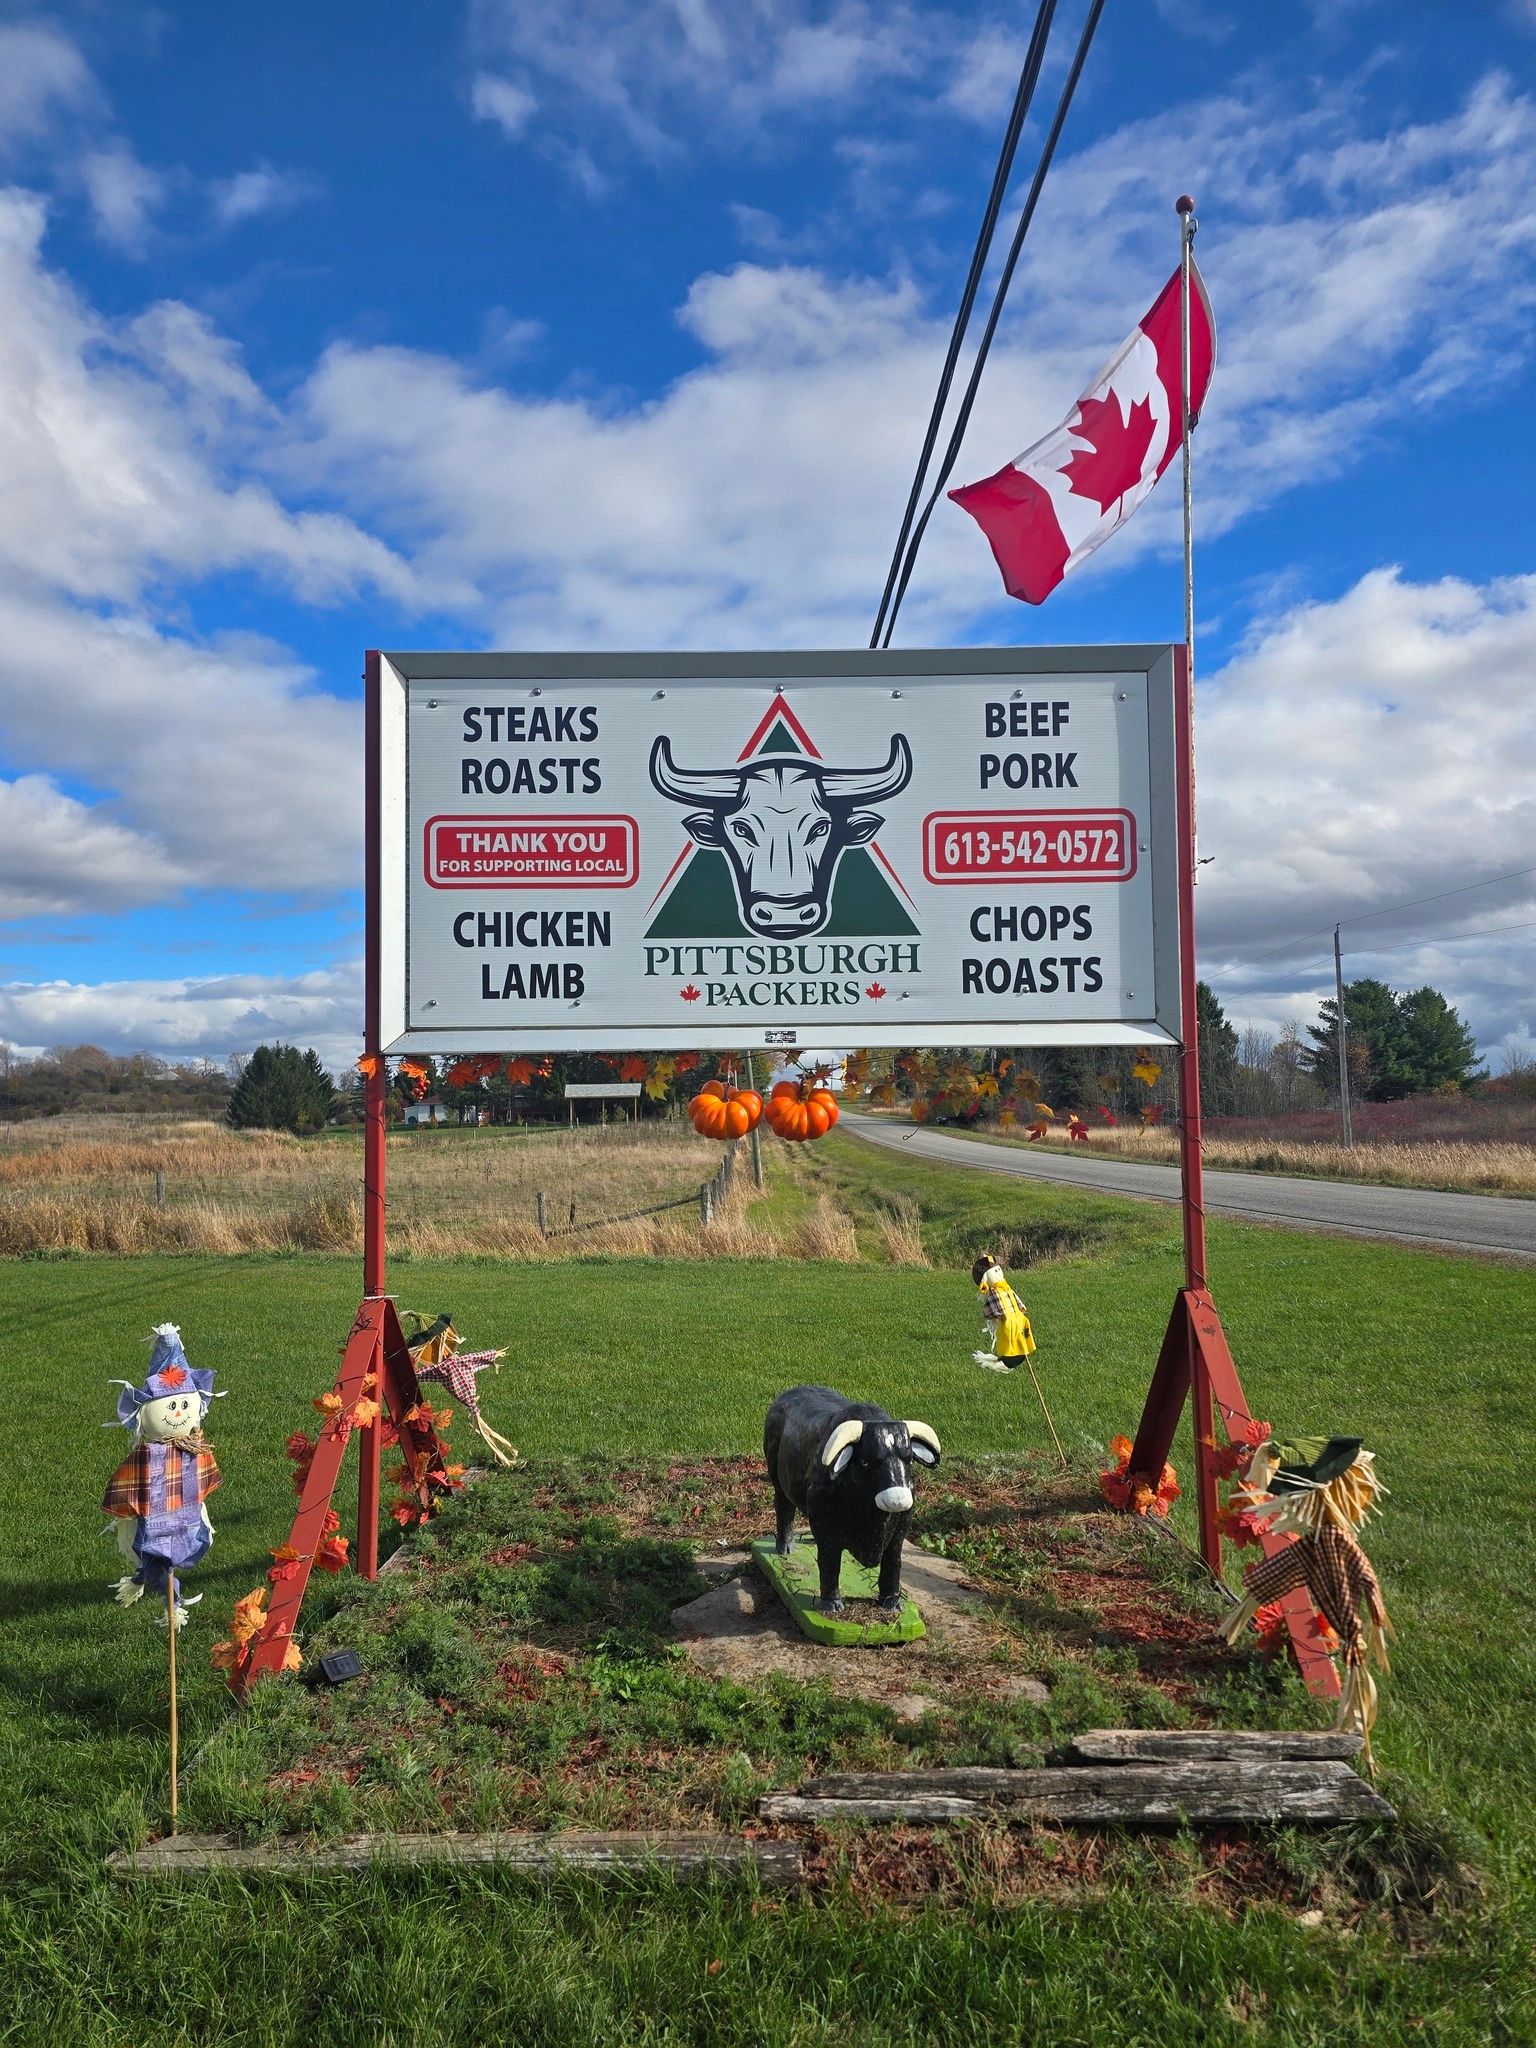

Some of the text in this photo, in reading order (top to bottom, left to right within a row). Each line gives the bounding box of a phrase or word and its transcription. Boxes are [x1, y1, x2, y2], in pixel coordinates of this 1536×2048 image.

[463, 706, 599, 743] STEAKS
[986, 702, 1070, 738] BEEF
[462, 758, 602, 795] ROASTS
[980, 753, 1079, 790] PORK
[457, 832, 606, 853] THANK YOU
[944, 829, 1120, 865] 613-542-0572
[439, 859, 625, 873] FOR SUPPORTING LOCAL
[454, 911, 611, 948] CHICKEN
[970, 905, 1093, 942] CHOPS
[643, 944, 922, 976] PITTSBURGH
[963, 957, 1103, 994] ROASTS
[482, 963, 585, 1000] LAMB
[705, 981, 861, 1007] PACKERS
